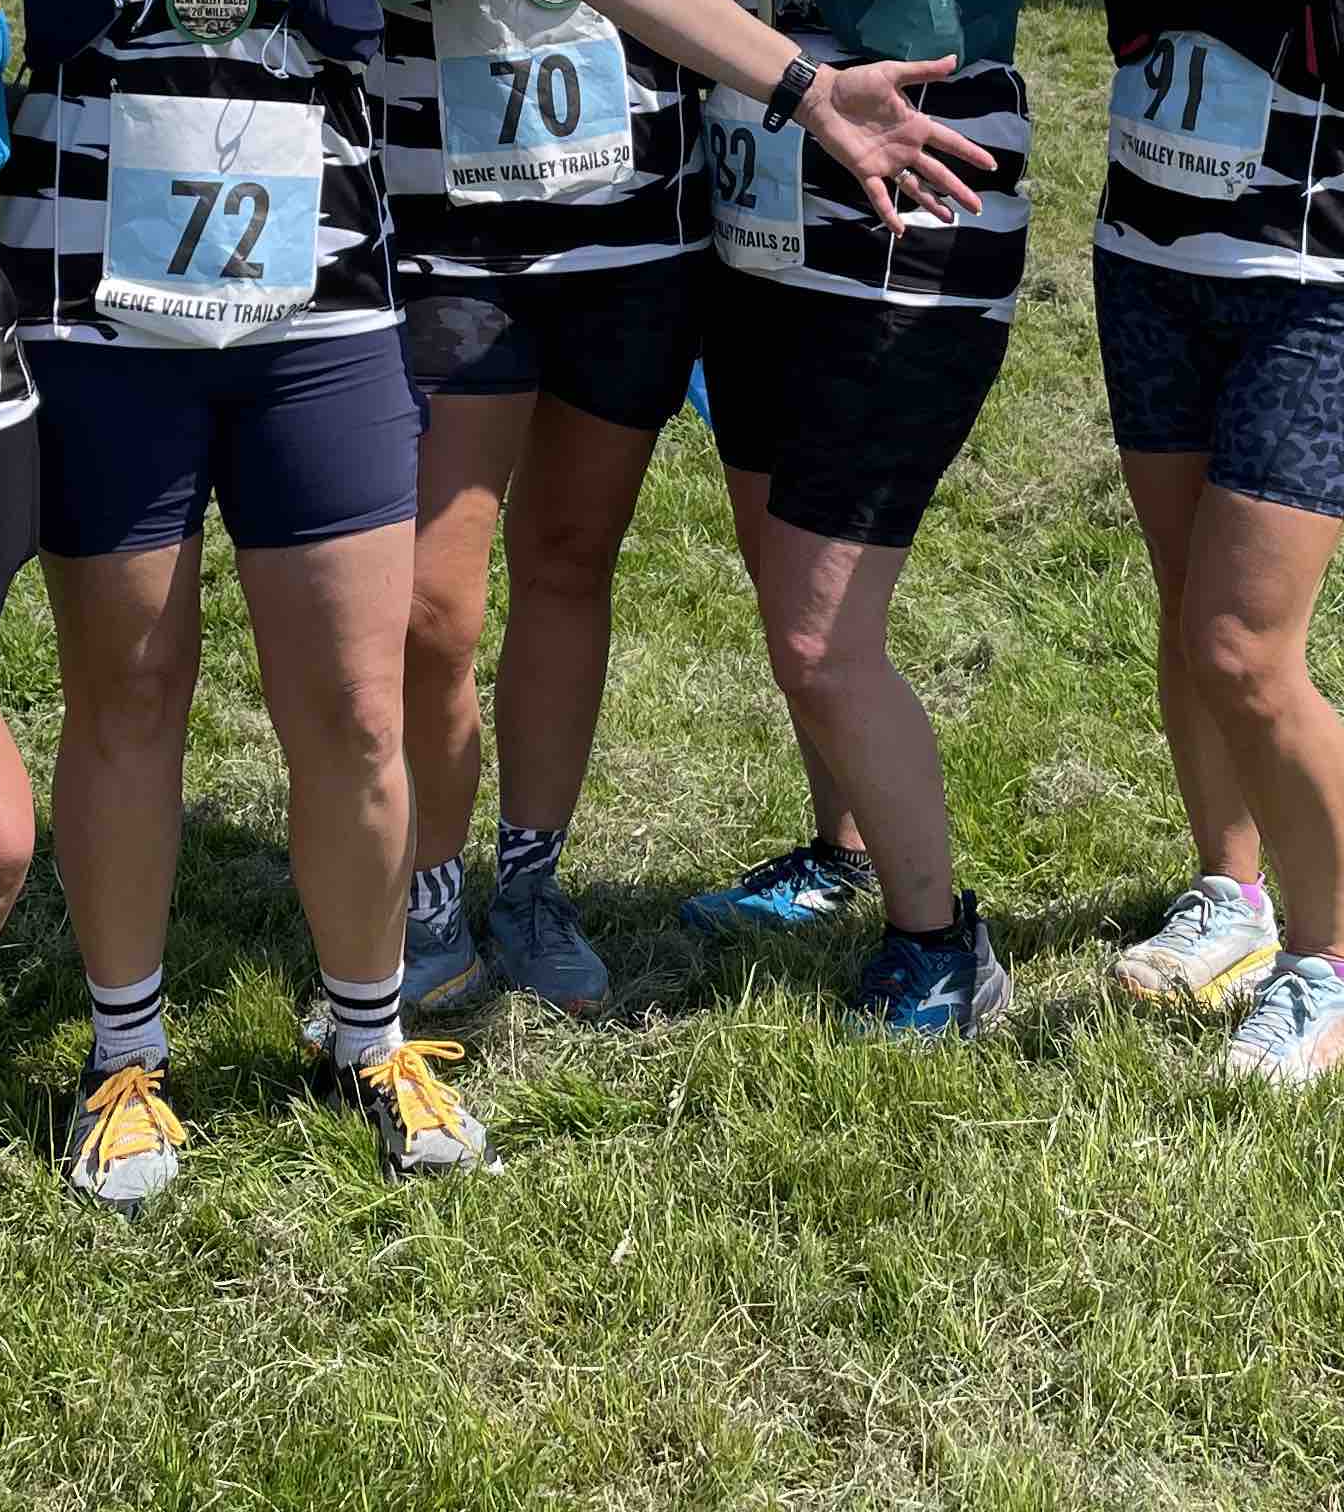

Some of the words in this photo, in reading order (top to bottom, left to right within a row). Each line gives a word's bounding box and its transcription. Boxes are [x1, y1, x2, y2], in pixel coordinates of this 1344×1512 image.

[489, 53, 581, 145] 70
[1144, 38, 1208, 131] 91
[453, 167, 496, 185] NENE
[499, 159, 558, 182] VALLEY
[560, 150, 610, 174] TRAILS
[613, 145, 630, 164] 20
[1135, 138, 1174, 166] VALLEY
[1178, 151, 1231, 177] TRAILS
[167, 179, 270, 280] 72
[735, 227, 778, 250] TRAILS
[782, 235, 800, 253] 20
[104, 290, 155, 313] NENE
[160, 298, 229, 323] VALLEY
[233, 303, 283, 324] TRAILS
